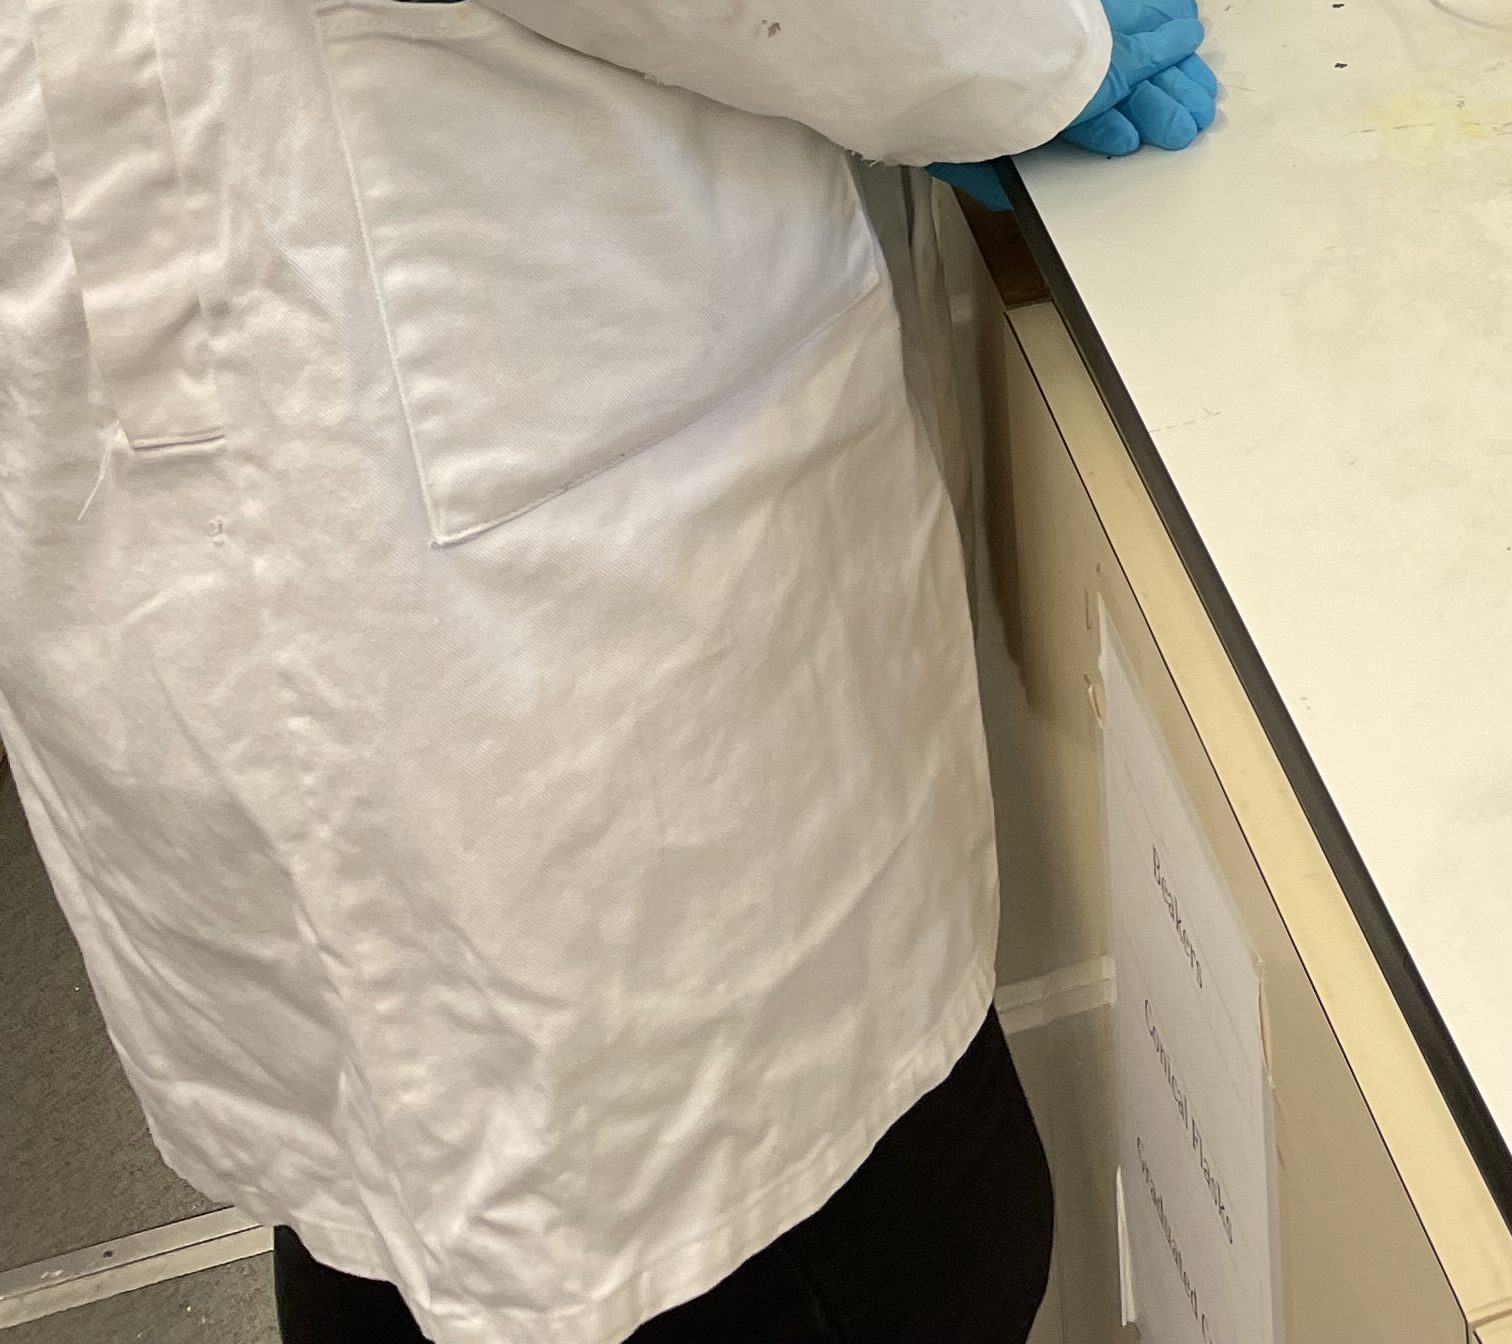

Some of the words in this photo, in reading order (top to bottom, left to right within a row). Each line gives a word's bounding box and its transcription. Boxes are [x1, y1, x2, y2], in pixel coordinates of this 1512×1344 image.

[1151, 843, 1206, 990] Beakers
[1145, 999, 1189, 1132] Conical
[1191, 1118, 1236, 1246] Flasks
